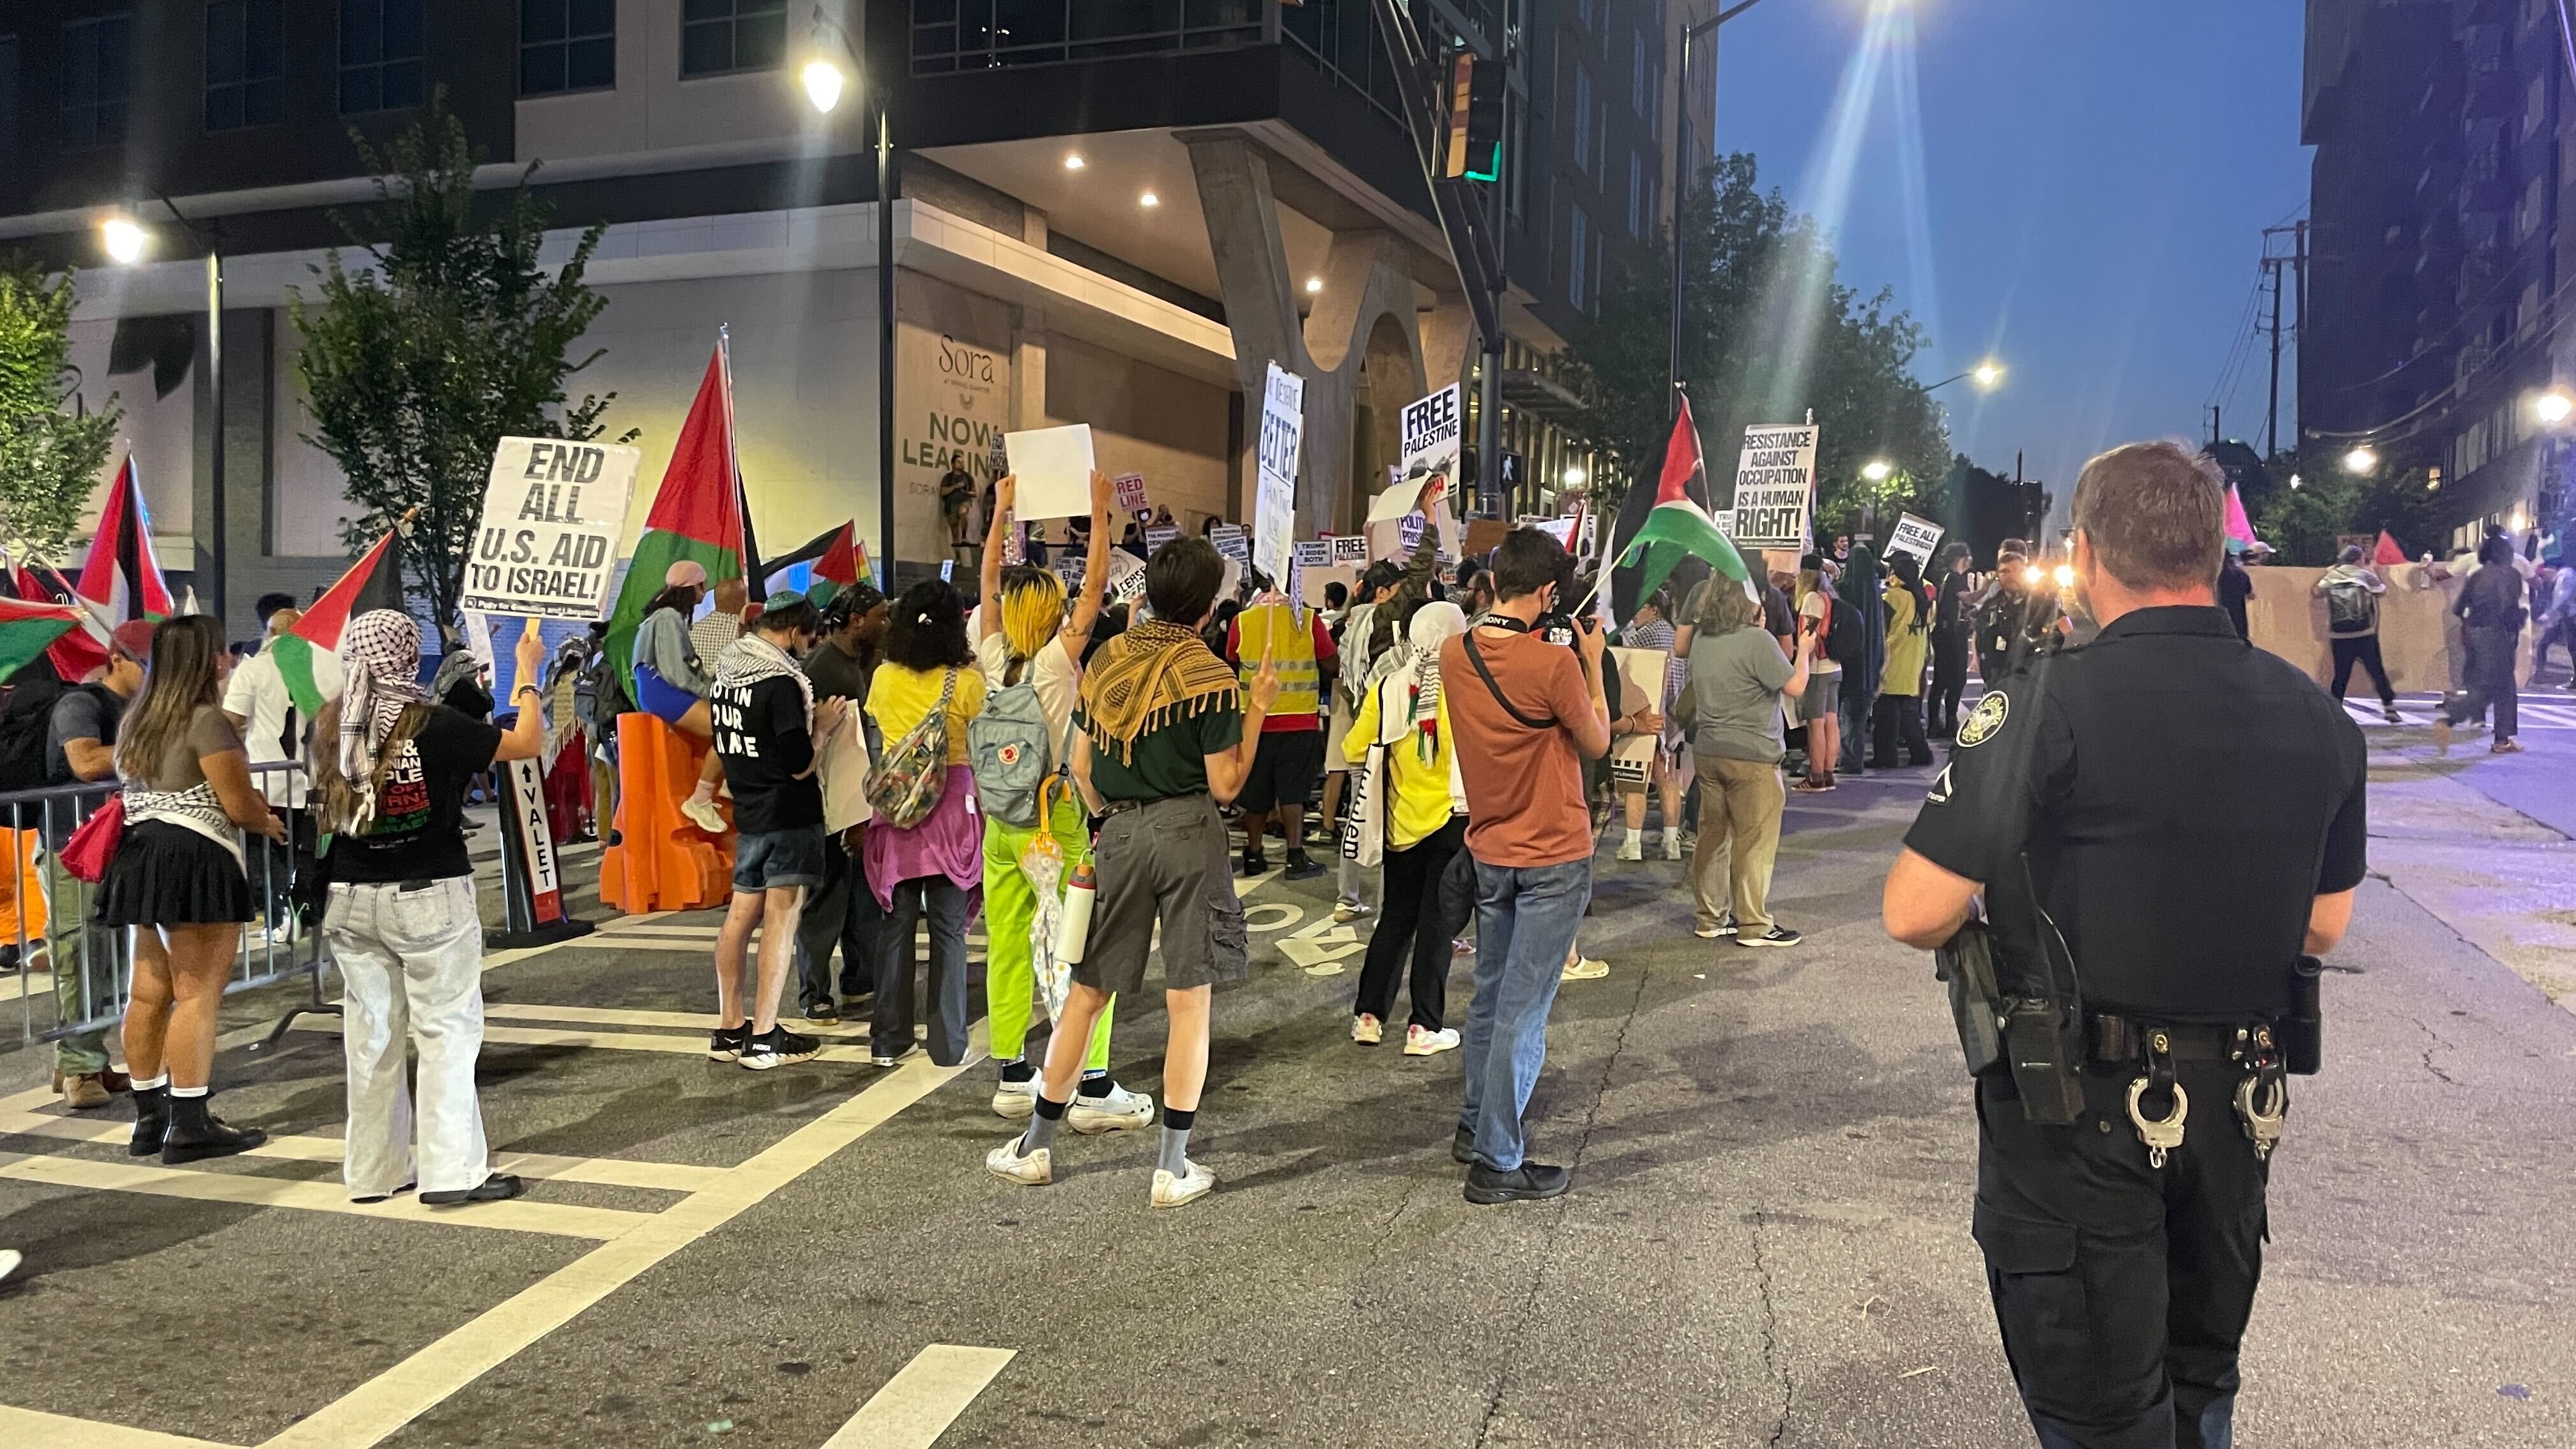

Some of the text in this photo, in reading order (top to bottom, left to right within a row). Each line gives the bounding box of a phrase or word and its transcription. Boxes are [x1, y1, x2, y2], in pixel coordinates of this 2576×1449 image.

[939, 334, 994, 384] Sora
[1407, 388, 1454, 440] FREE
[930, 412, 998, 447] NOW
[1404, 418, 1458, 457] PALESTINE
[1743, 431, 1811, 450] RESISTANCE
[1262, 410, 1298, 484] BETTER
[1751, 450, 1798, 468] AGAINST
[523, 443, 604, 484] END
[1738, 468, 1807, 486] OCCUPATION
[1116, 479, 1143, 494] RED
[1120, 493, 1147, 508] LINE
[1738, 490, 1804, 507] IS A HUMAN
[518, 483, 584, 525] ALL
[1735, 508, 1802, 537] RIGHT!
[1898, 522, 1936, 543] FREE ALL
[480, 528, 608, 569] U.S. AID
[1335, 539, 1366, 553] FREE
[471, 563, 602, 599] TO ISRAEL!
[733, 687, 753, 708] IN
[402, 739, 418, 757] &
[523, 787, 551, 887] VALET
